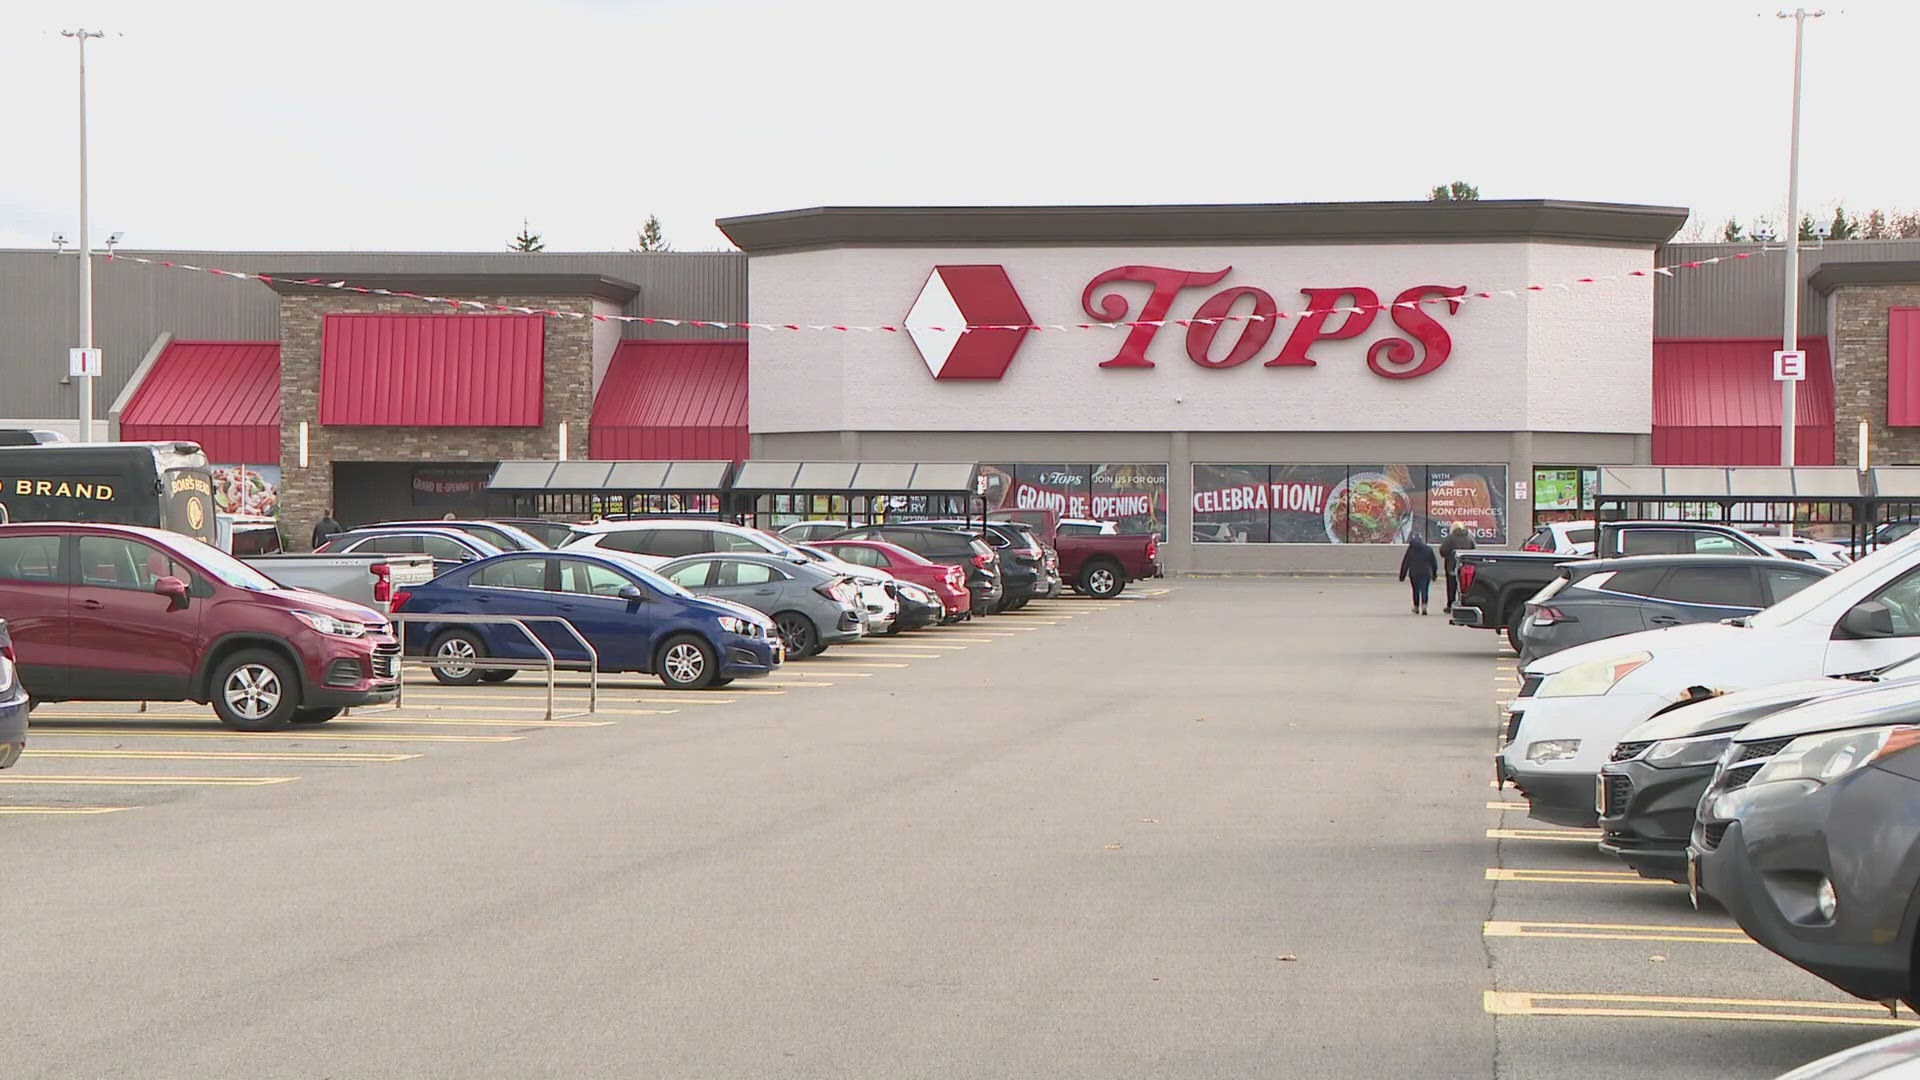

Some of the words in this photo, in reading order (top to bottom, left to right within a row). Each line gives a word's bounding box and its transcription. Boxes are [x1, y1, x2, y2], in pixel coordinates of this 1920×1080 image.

[82, 352, 86, 372] I
[1782, 355, 1798, 376] E
[1093, 475, 1113, 484] JOIN
[1115, 475, 1126, 484] US
[1128, 475, 1145, 484] FOR
[1146, 475, 1165, 484] OUR
[16, 480, 113, 501] BRAND
[1017, 484, 1066, 516] GRAND
[1431, 508, 1503, 516] CONVENIENCES
[1440, 528, 1497, 539] SNGS!
